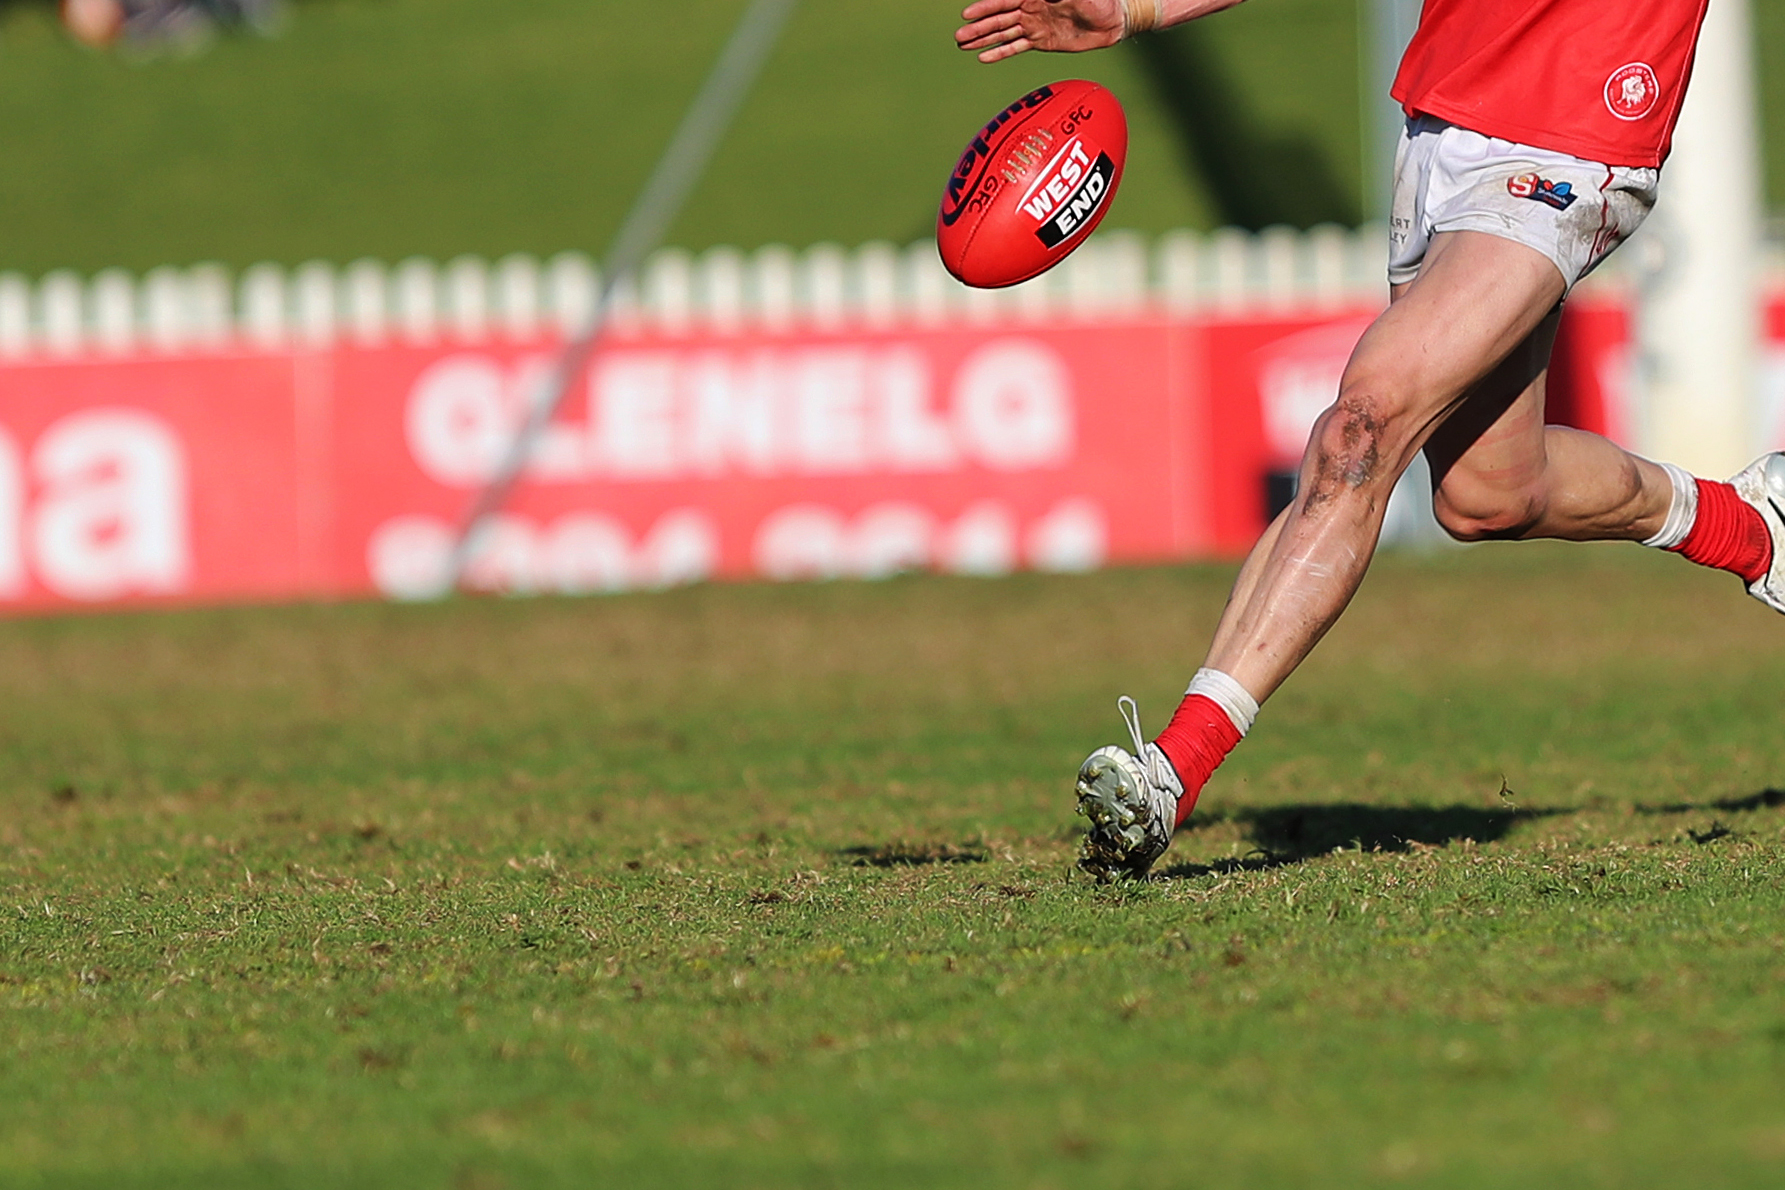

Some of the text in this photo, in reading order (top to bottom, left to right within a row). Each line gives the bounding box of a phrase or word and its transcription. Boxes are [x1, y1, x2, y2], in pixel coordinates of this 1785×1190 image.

[1060, 104, 1093, 136] GFC
[970, 175, 999, 213] GFC
[1023, 140, 1091, 221] WEST
[1055, 171, 1106, 236] END
[408, 340, 1074, 485] GLENELG
